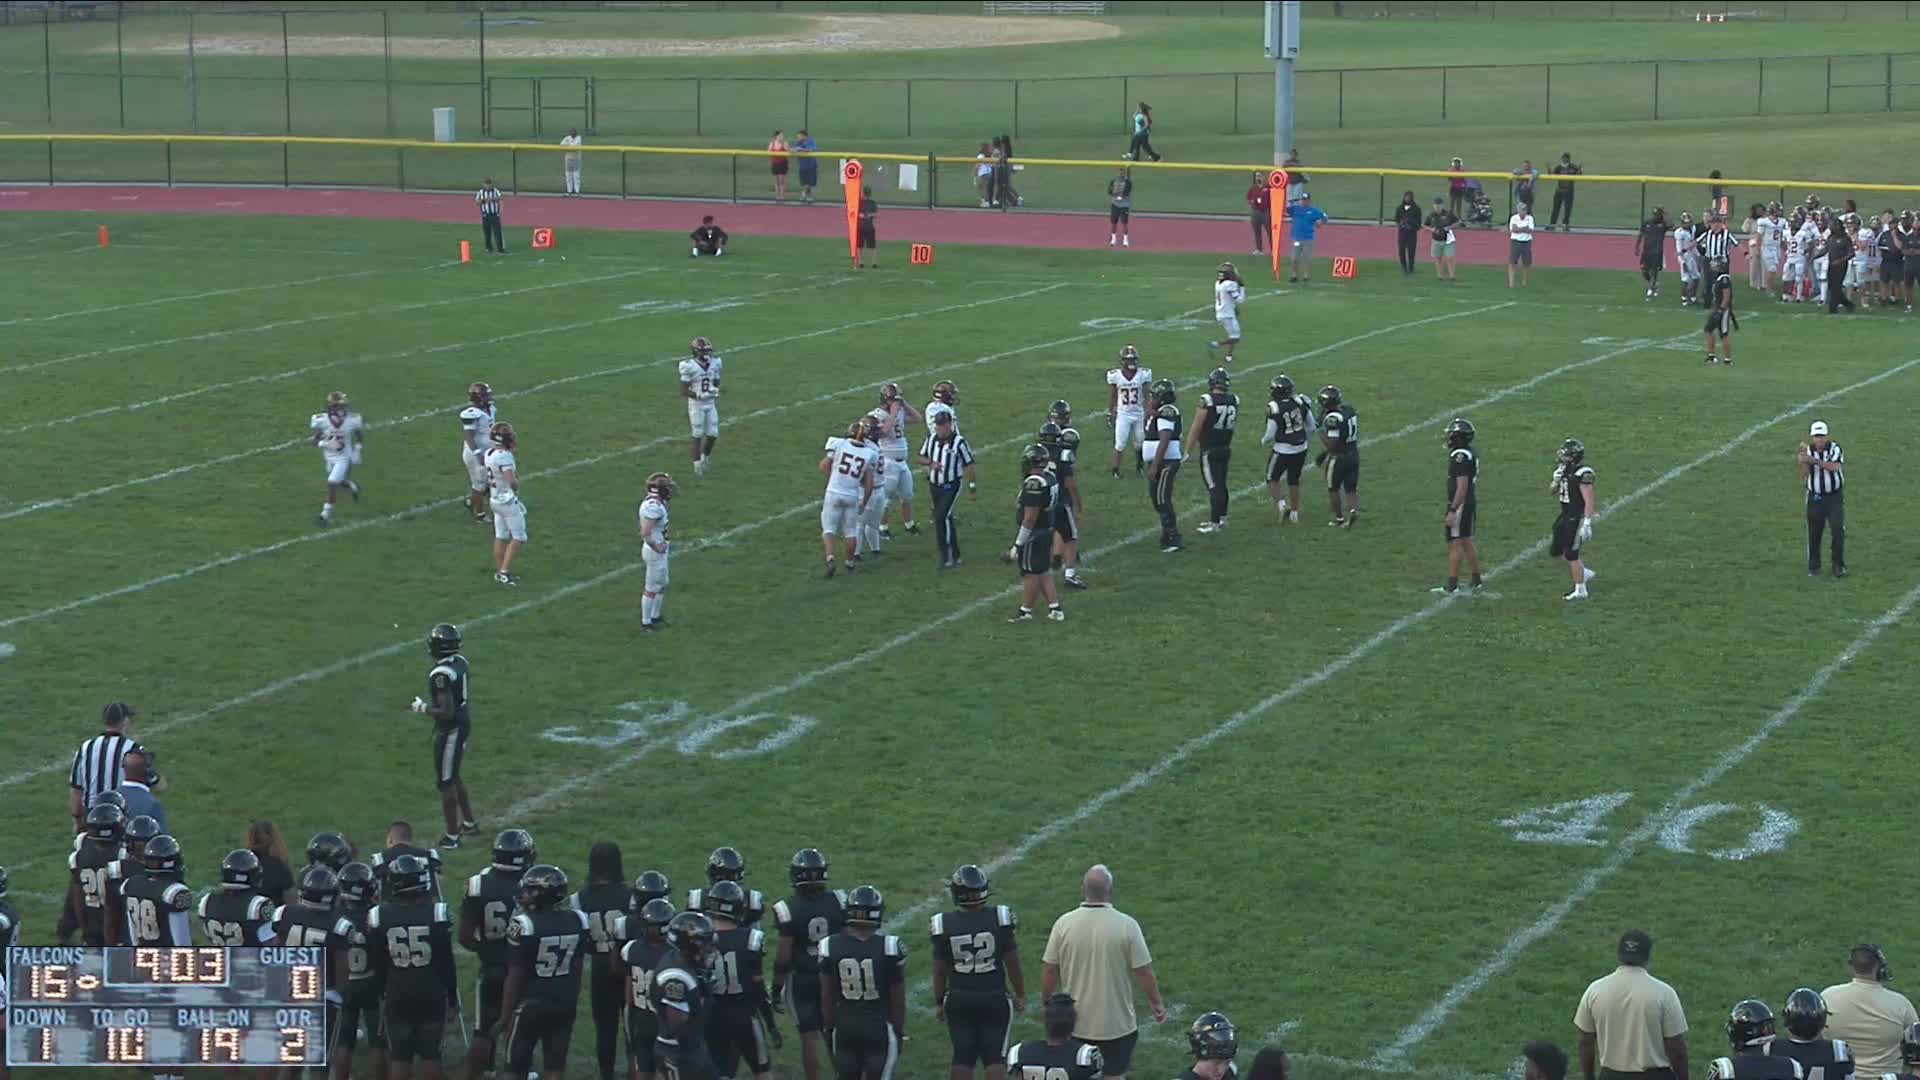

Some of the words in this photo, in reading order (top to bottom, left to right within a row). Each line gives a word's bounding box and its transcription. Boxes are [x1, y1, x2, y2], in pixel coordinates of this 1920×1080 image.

[534, 231, 548, 246] G
[913, 246, 928, 261] 10
[1335, 258, 1351, 275] 20
[1120, 387, 1139, 405] 33
[1213, 405, 1236, 430] 72
[838, 452, 865, 479] 53
[1500, 790, 1801, 861] 40
[386, 925, 433, 968] 65
[535, 934, 580, 978] 57
[949, 931, 997, 974] 52
[838, 957, 880, 1001] 81
